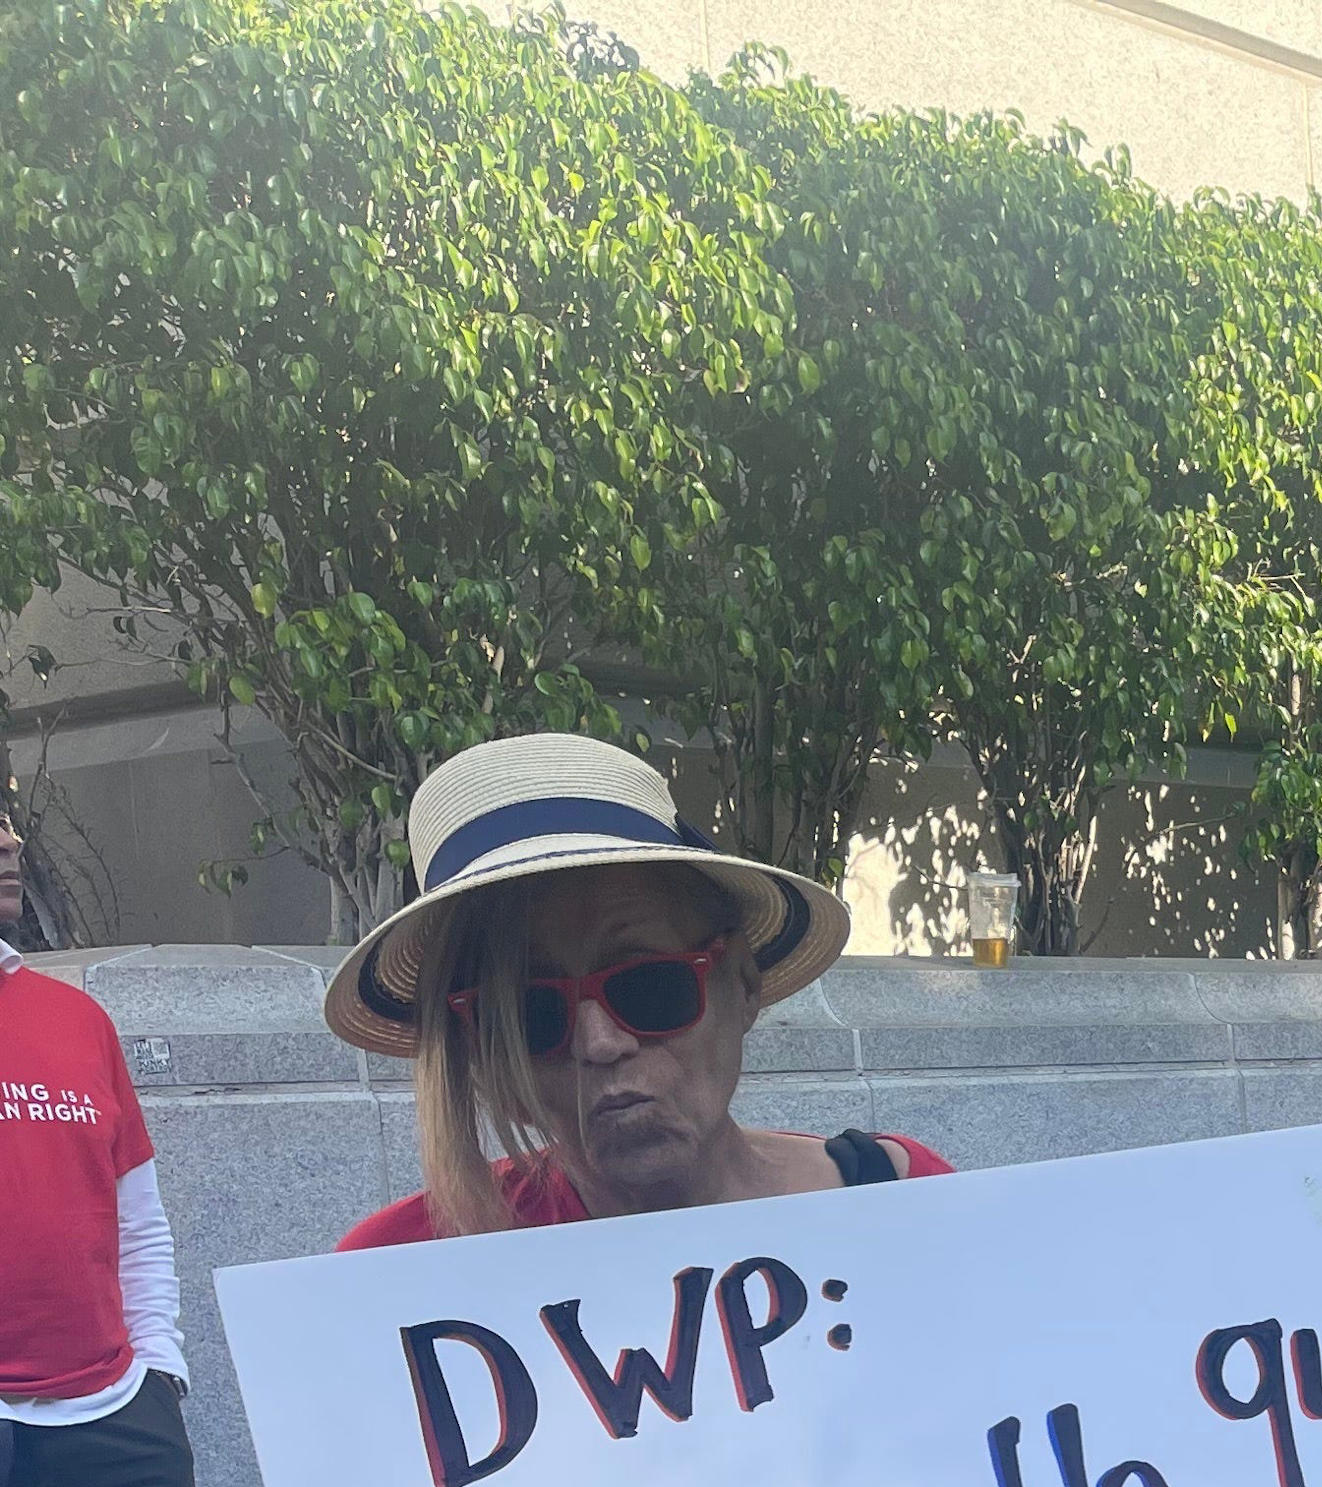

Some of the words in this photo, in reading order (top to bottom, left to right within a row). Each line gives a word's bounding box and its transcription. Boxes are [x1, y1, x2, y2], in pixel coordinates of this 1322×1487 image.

[60, 1089, 77, 1103] IS
[83, 1094, 94, 1106] A
[27, 1102, 97, 1125] RIGHT
